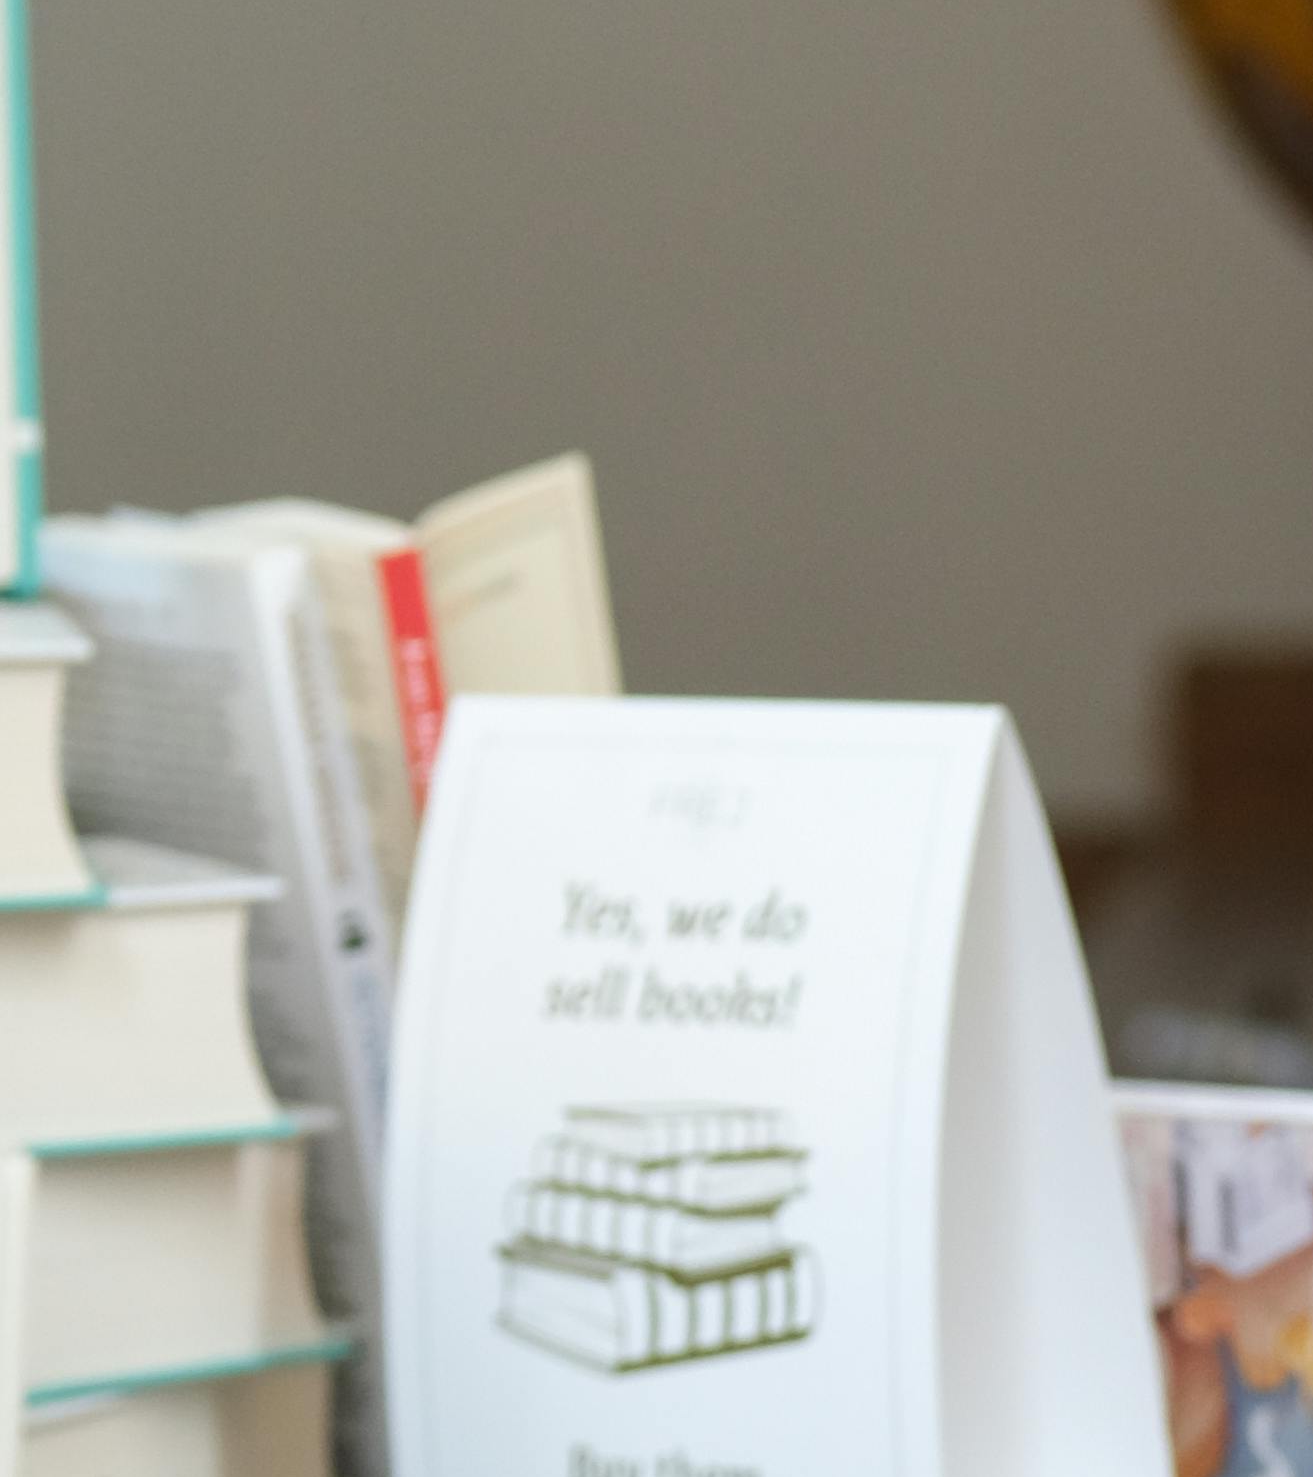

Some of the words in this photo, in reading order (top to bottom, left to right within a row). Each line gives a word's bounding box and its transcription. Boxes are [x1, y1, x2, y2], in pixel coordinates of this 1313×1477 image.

[560, 878, 644, 946] Yes,
[664, 899, 733, 938] we
[740, 885, 811, 942] do
[545, 967, 629, 1021] sell
[637, 969, 804, 1027] books!
